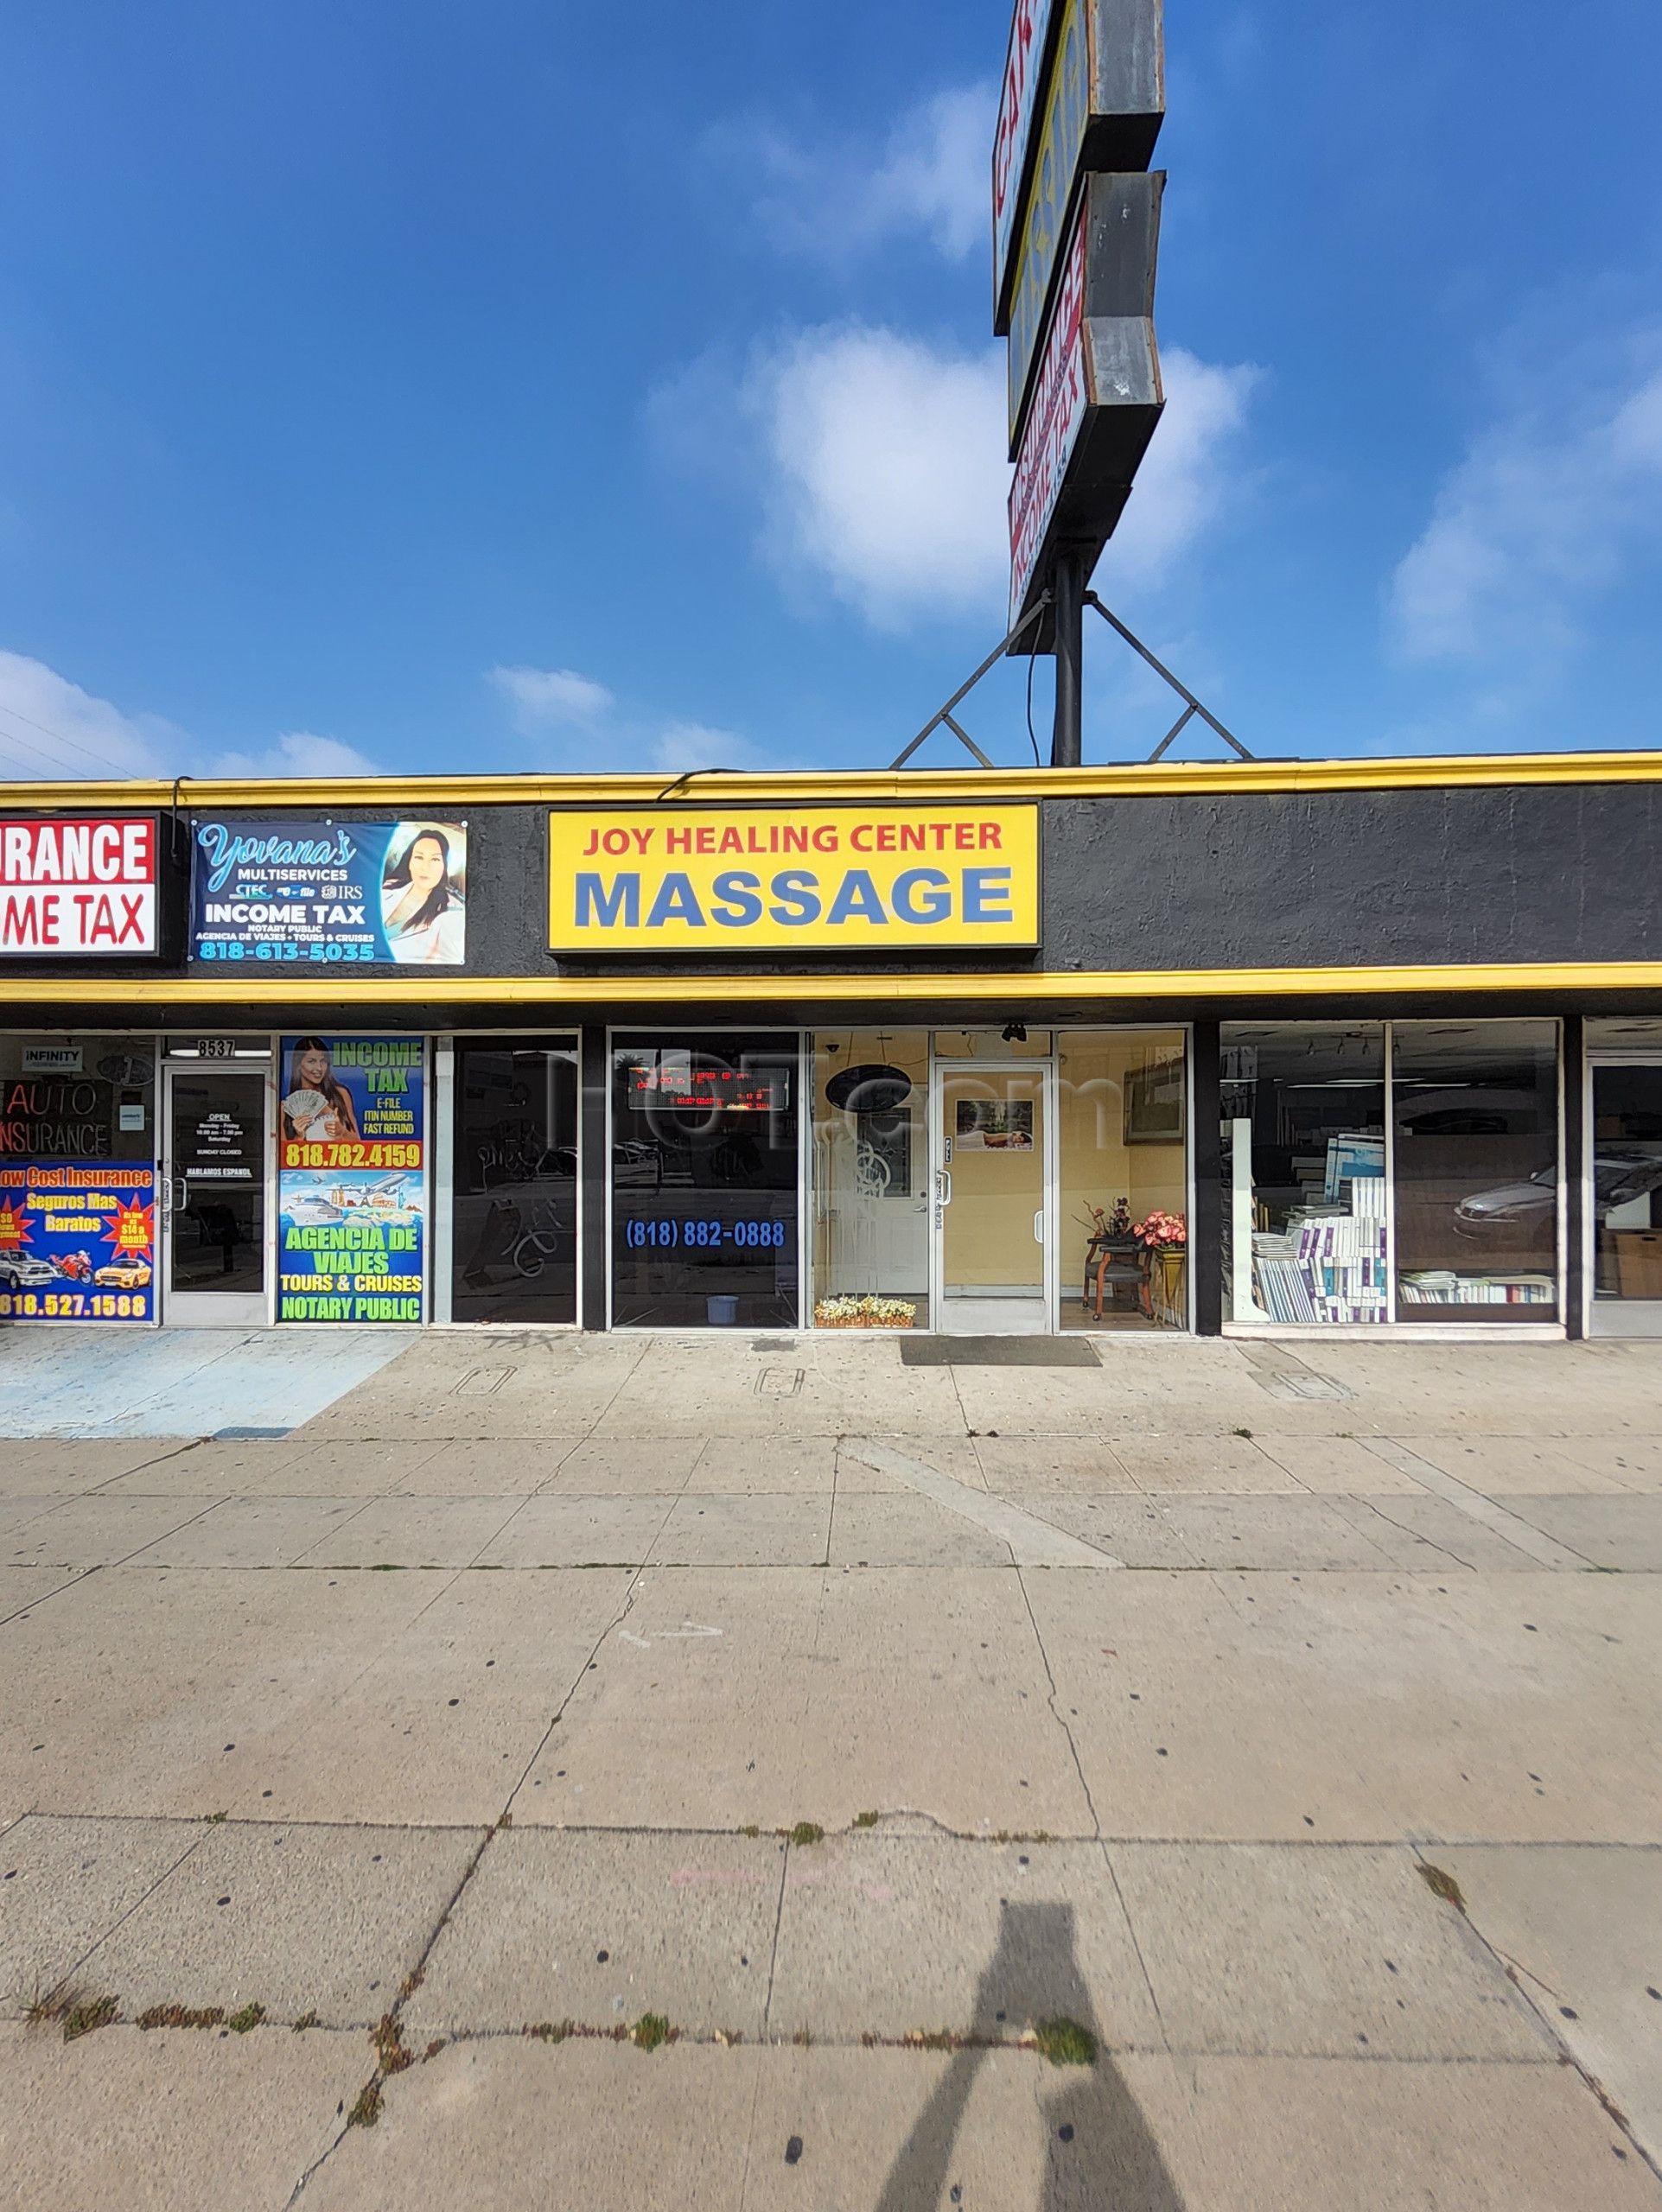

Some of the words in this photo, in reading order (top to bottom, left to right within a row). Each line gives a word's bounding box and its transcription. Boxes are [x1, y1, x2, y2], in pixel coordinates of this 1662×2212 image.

[1011, 221, 1084, 526] INSURANCE
[1013, 438, 1052, 605] INCOME
[1054, 344, 1079, 466] TAX
[583, 827, 655, 856] JOY
[666, 824, 839, 855] HEALING
[850, 822, 1003, 852] CENTER
[0, 823, 148, 881] RANCE
[198, 823, 357, 892] Yovana's
[238, 868, 348, 881] MULTISERVICES
[338, 886, 363, 899] IRS
[574, 866, 1014, 929] MASSAGE
[73, 893, 145, 945] TAX
[205, 904, 307, 924] INCOME
[312, 905, 366, 925] TAX
[195, 932, 237, 941] AGENCIA
[247, 925, 286, 933] NOTARY
[199, 942, 375, 961] 818-613-5035
[199, 1040, 234, 1057] 8537
[332, 1041, 423, 1067] INCOME
[364, 1068, 408, 1094] TAX
[6, 1083, 97, 1116] AUTO
[376, 1097, 401, 1109] E-FILE
[364, 1110, 380, 1122] ITIN
[380, 1110, 413, 1122] NUMBER
[363, 1123, 383, 1135] FAST
[383, 1123, 414, 1135] REFUND
[285, 1143, 421, 1167] 818.782.4159
[27, 1166, 65, 1188] Cost
[67, 1166, 153, 1188] Insurance
[187, 1167, 221, 1176] HABLAMOS
[27, 1192, 86, 1211] Seguros
[86, 1192, 118, 1210] Mas
[45, 1215, 102, 1232] Baratos
[121, 1224, 137, 1234] $14
[627, 1219, 678, 1249] (818)
[684, 1221, 785, 1246] 882-0888
[119, 1235, 149, 1244] month
[285, 1227, 385, 1251] AGENCIA
[388, 1227, 418, 1251] DE
[313, 1251, 390, 1274] VIAJES
[280, 1274, 334, 1292] TOURS
[337, 1274, 350, 1292] &
[354, 1274, 423, 1293] CRUISES
[0, 1294, 146, 1317] 818.527.1588
[282, 1296, 353, 1319] NOTARY
[354, 1297, 420, 1320] PUBLIC
